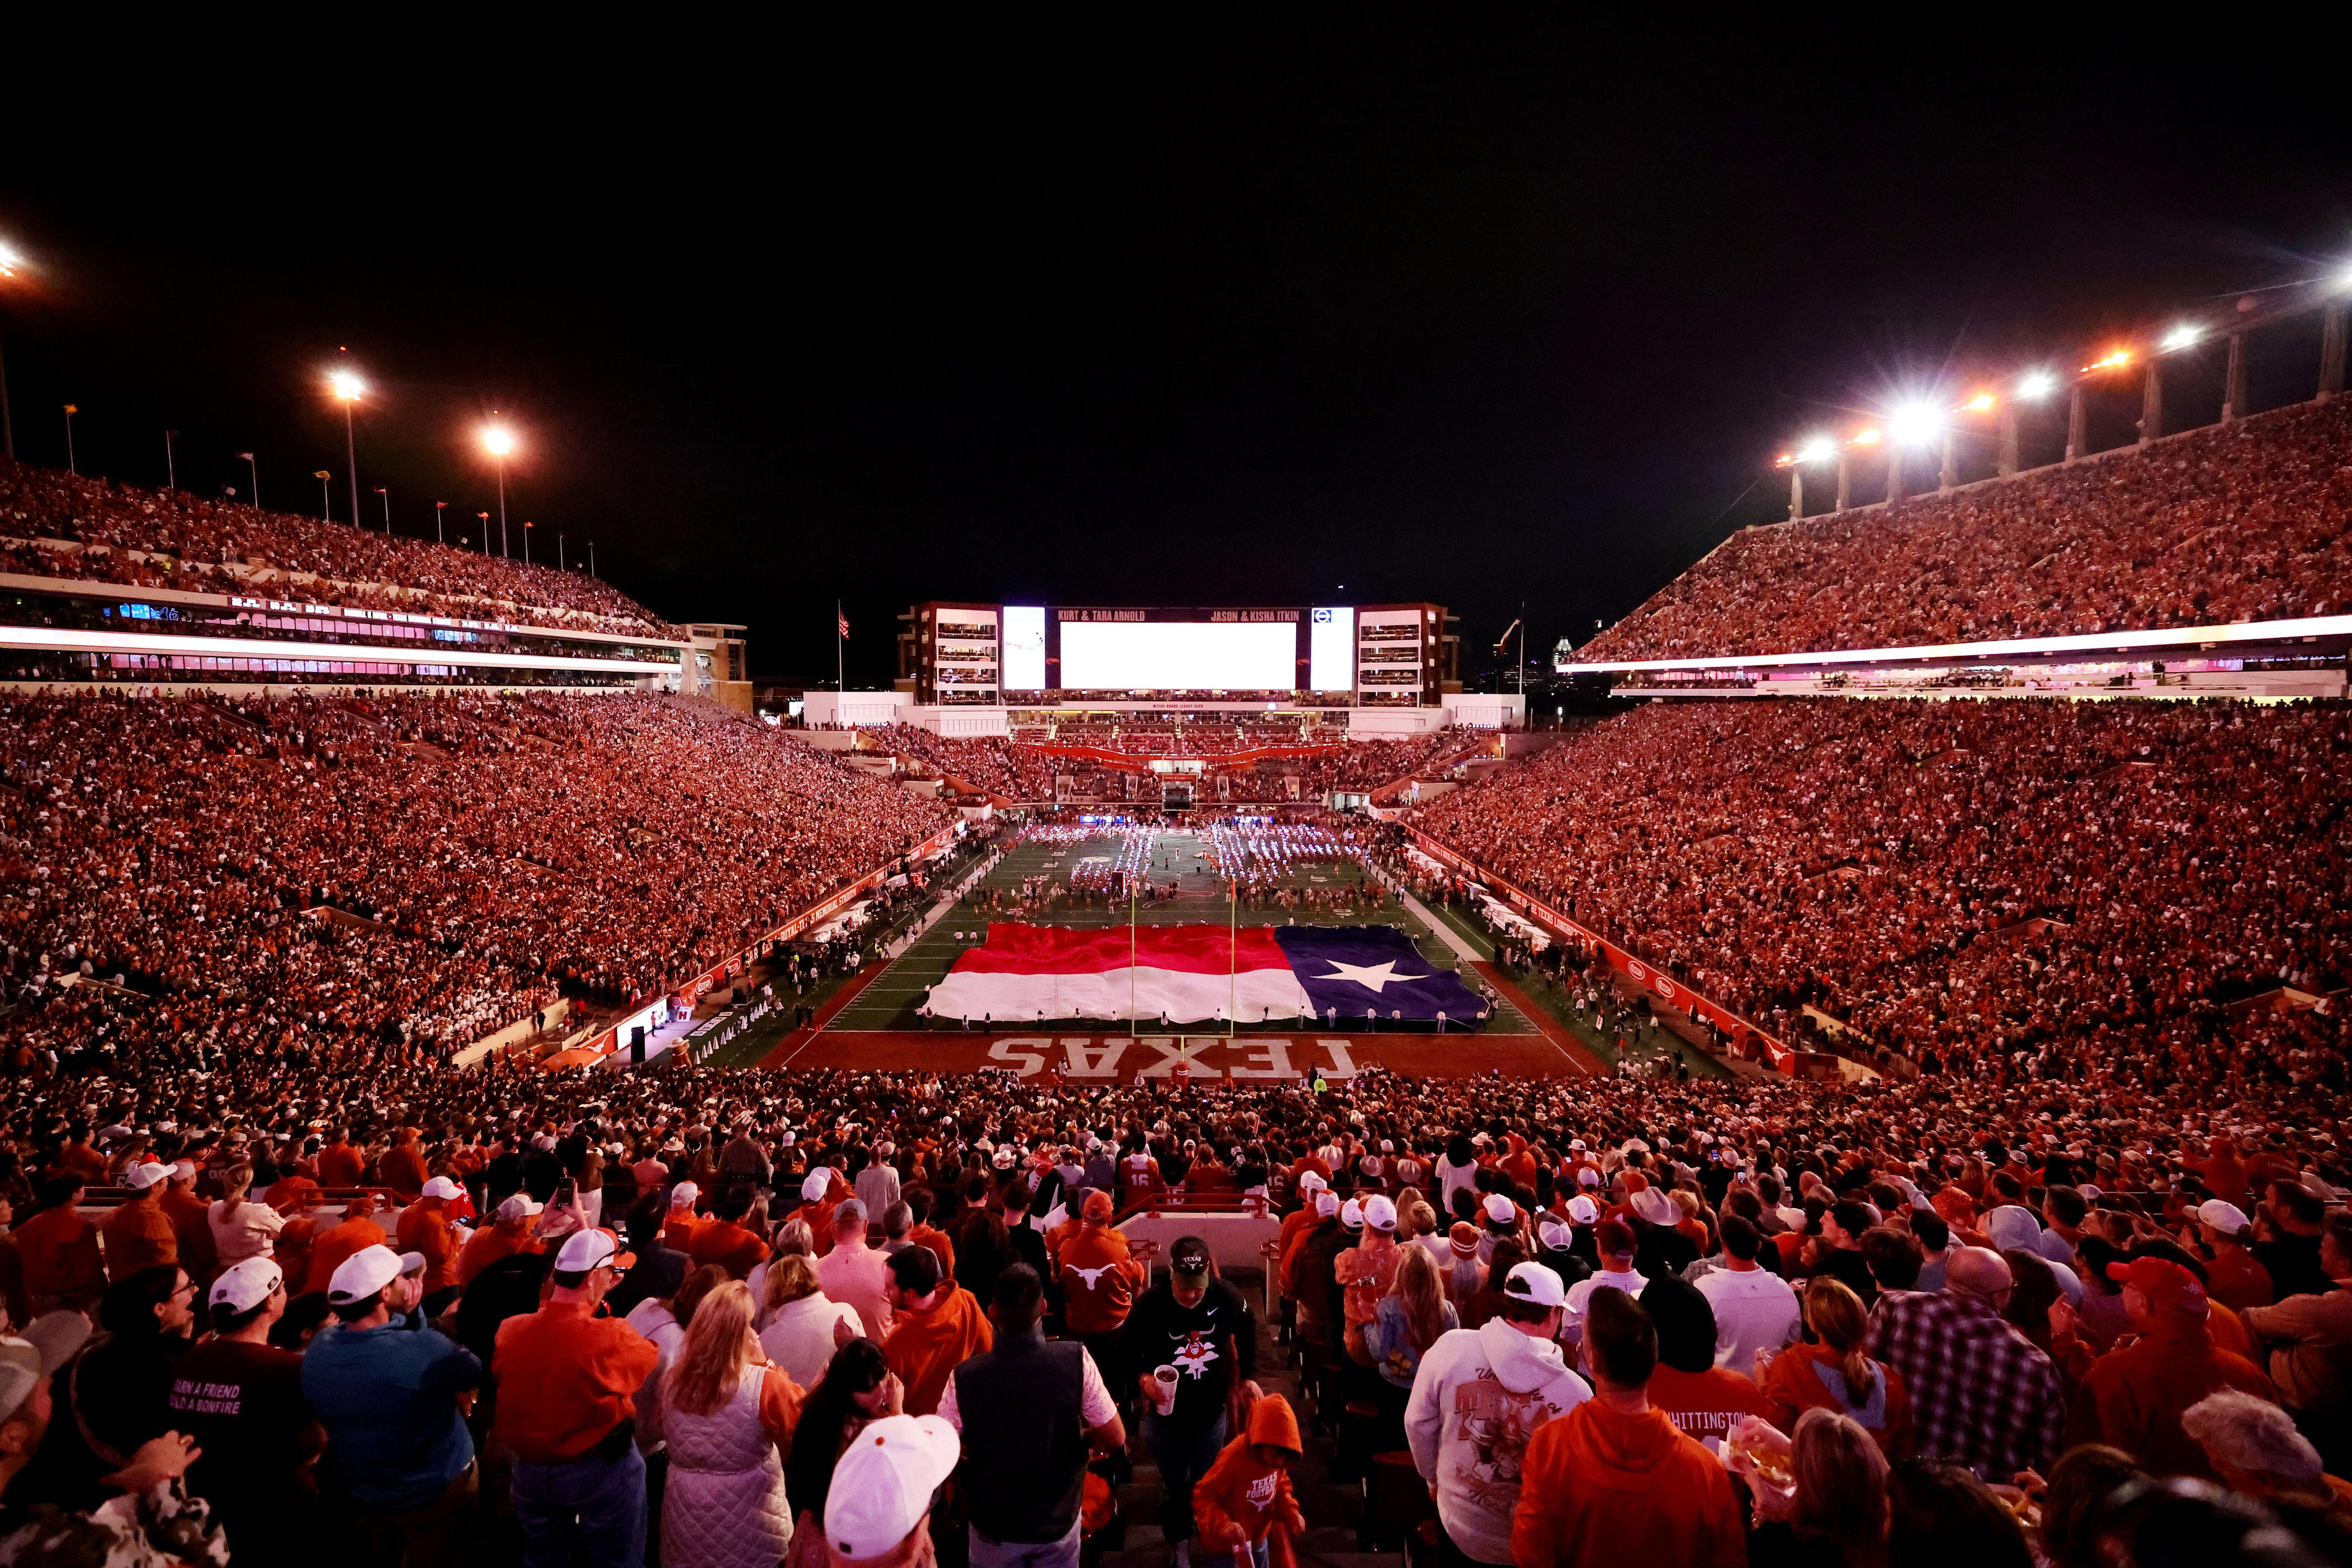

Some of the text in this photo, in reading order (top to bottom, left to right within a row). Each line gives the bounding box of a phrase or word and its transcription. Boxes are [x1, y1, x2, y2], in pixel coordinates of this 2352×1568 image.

[1058, 610, 1145, 621] KURT & TARA ARNOLD
[1211, 611, 1300, 621] JASON & KISHA ITKIN
[816, 899, 838, 921] MEMORIAL
[839, 888, 857, 906] STADIUM
[1538, 906, 1553, 924] TEXAS
[679, 1011, 687, 1020] H
[194, 1382, 201, 1395] A
[202, 1383, 240, 1398] FRIEND
[187, 1399, 194, 1410] A
[196, 1399, 241, 1414] BONFIRE
[1668, 1411, 1746, 1429] HITTINGTON
[1252, 1471, 1277, 1490] TEXAS
[1246, 1484, 1274, 1498] FOOTBA
